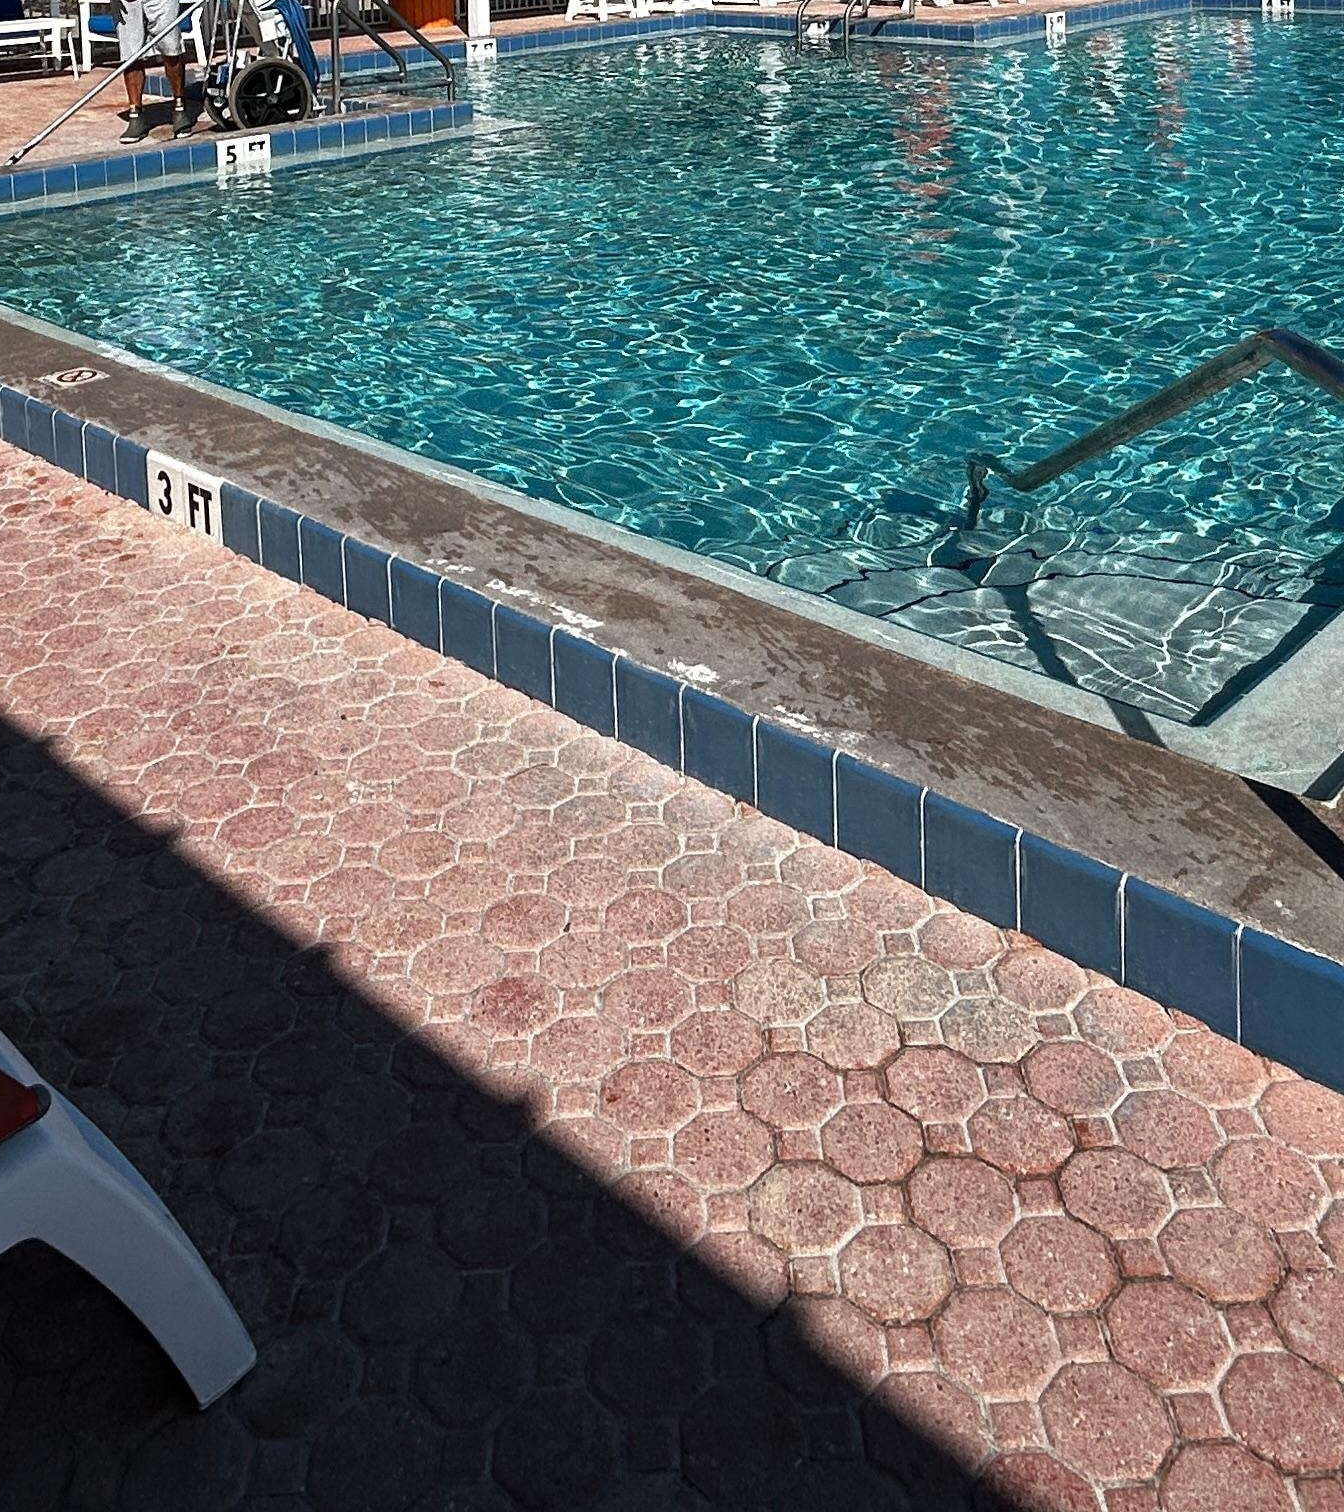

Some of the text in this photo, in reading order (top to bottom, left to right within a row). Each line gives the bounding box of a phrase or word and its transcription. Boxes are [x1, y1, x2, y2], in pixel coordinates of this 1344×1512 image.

[226, 140, 266, 165] 5 FT
[157, 470, 213, 536] 3 FT
